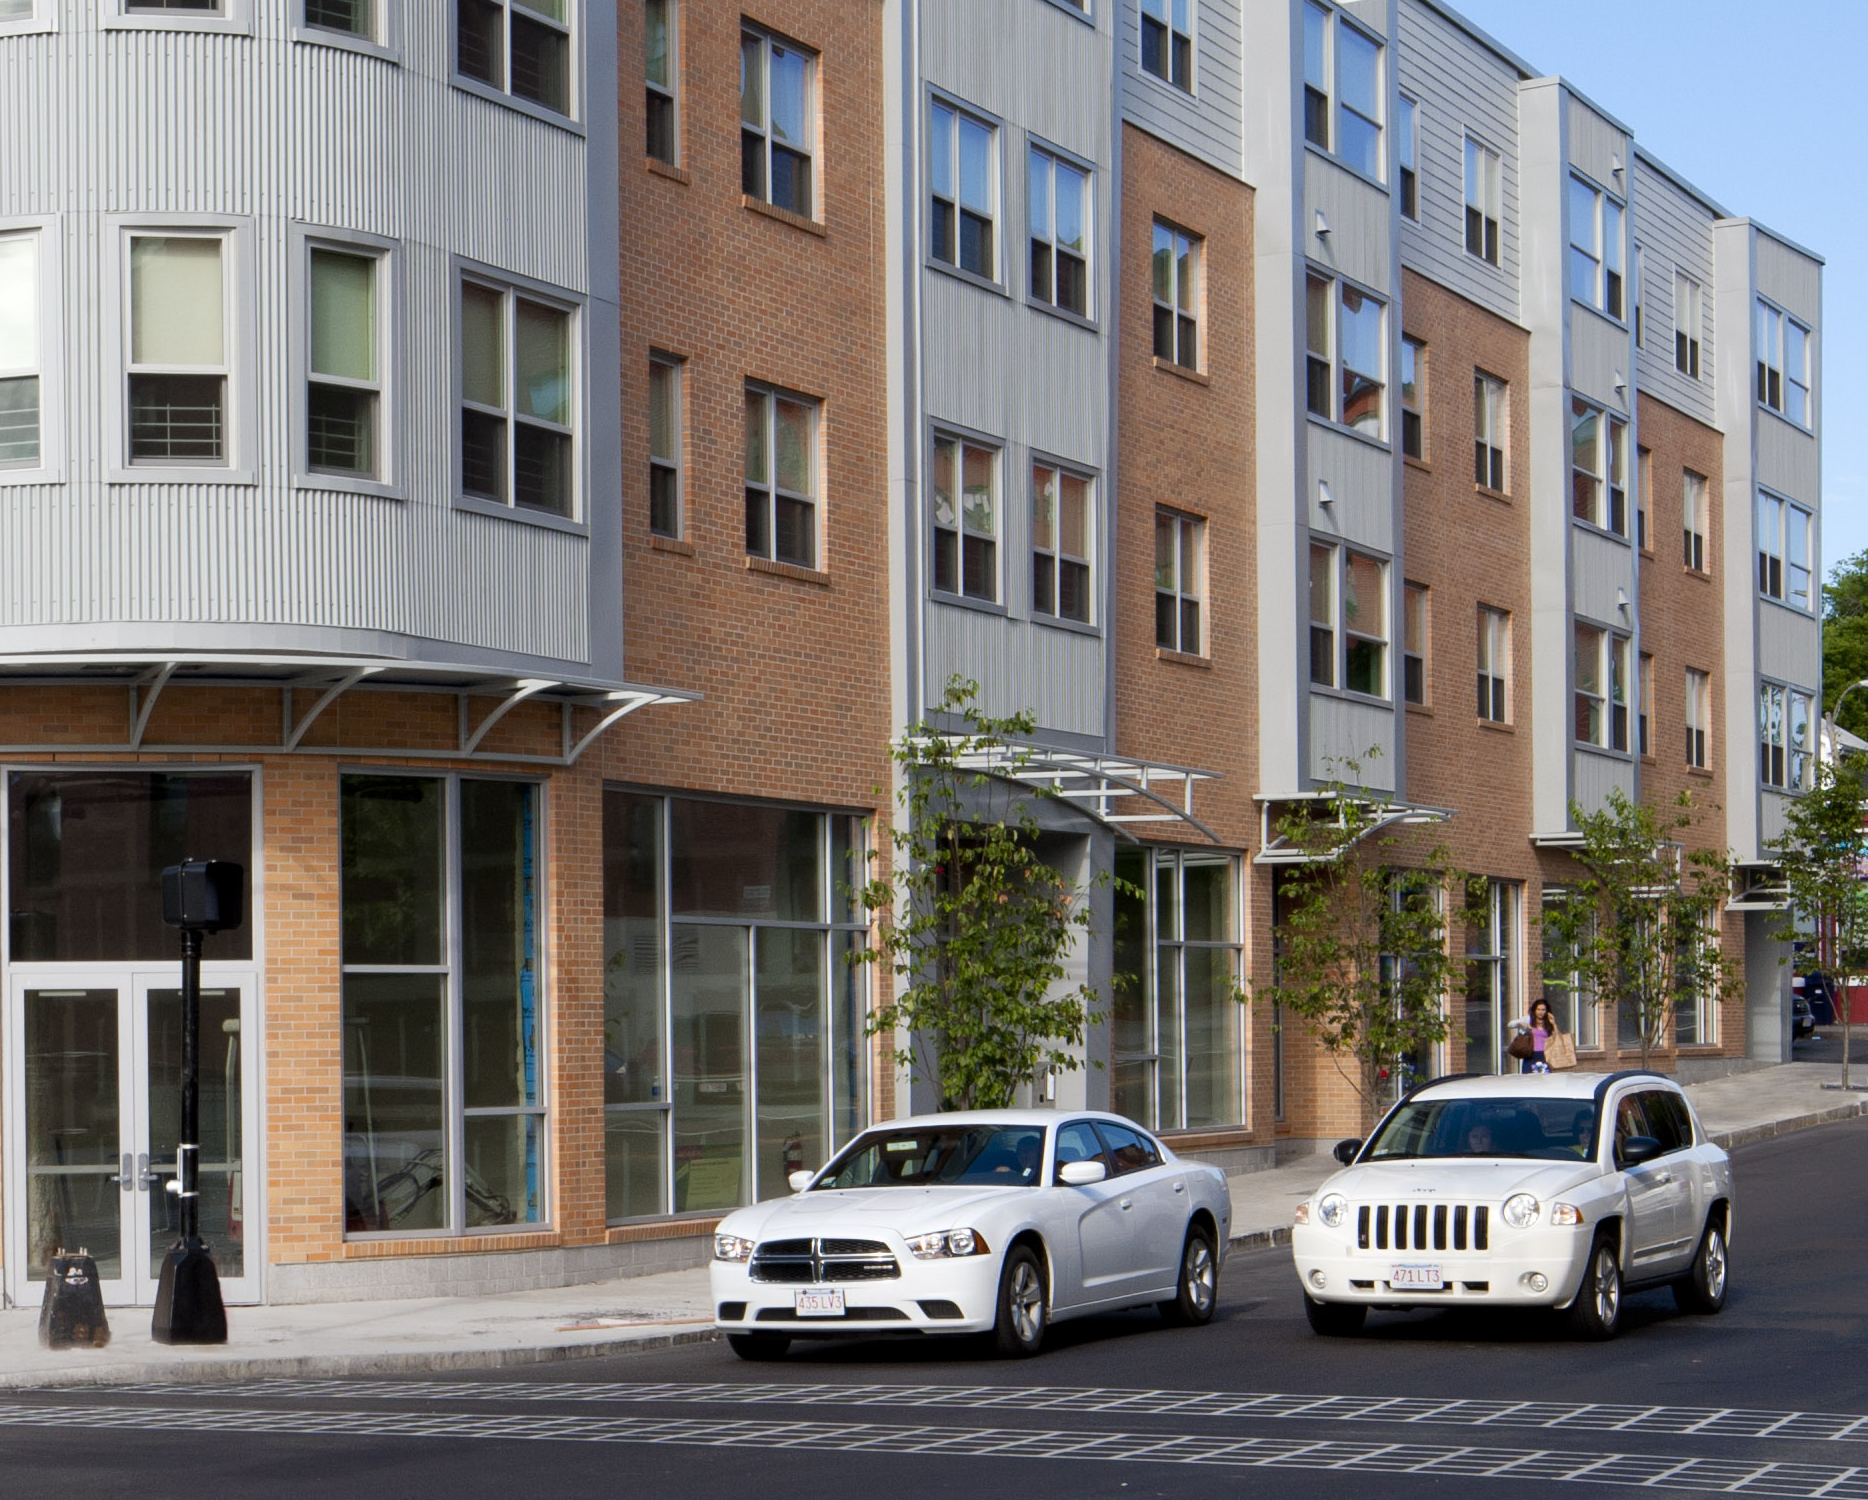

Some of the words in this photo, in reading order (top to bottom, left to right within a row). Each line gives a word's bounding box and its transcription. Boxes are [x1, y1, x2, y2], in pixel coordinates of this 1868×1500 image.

[1393, 1269, 1414, 1282] 471
[1417, 1269, 1440, 1282] LT3
[798, 1295, 819, 1309] 435
[821, 1295, 842, 1309] LV3
